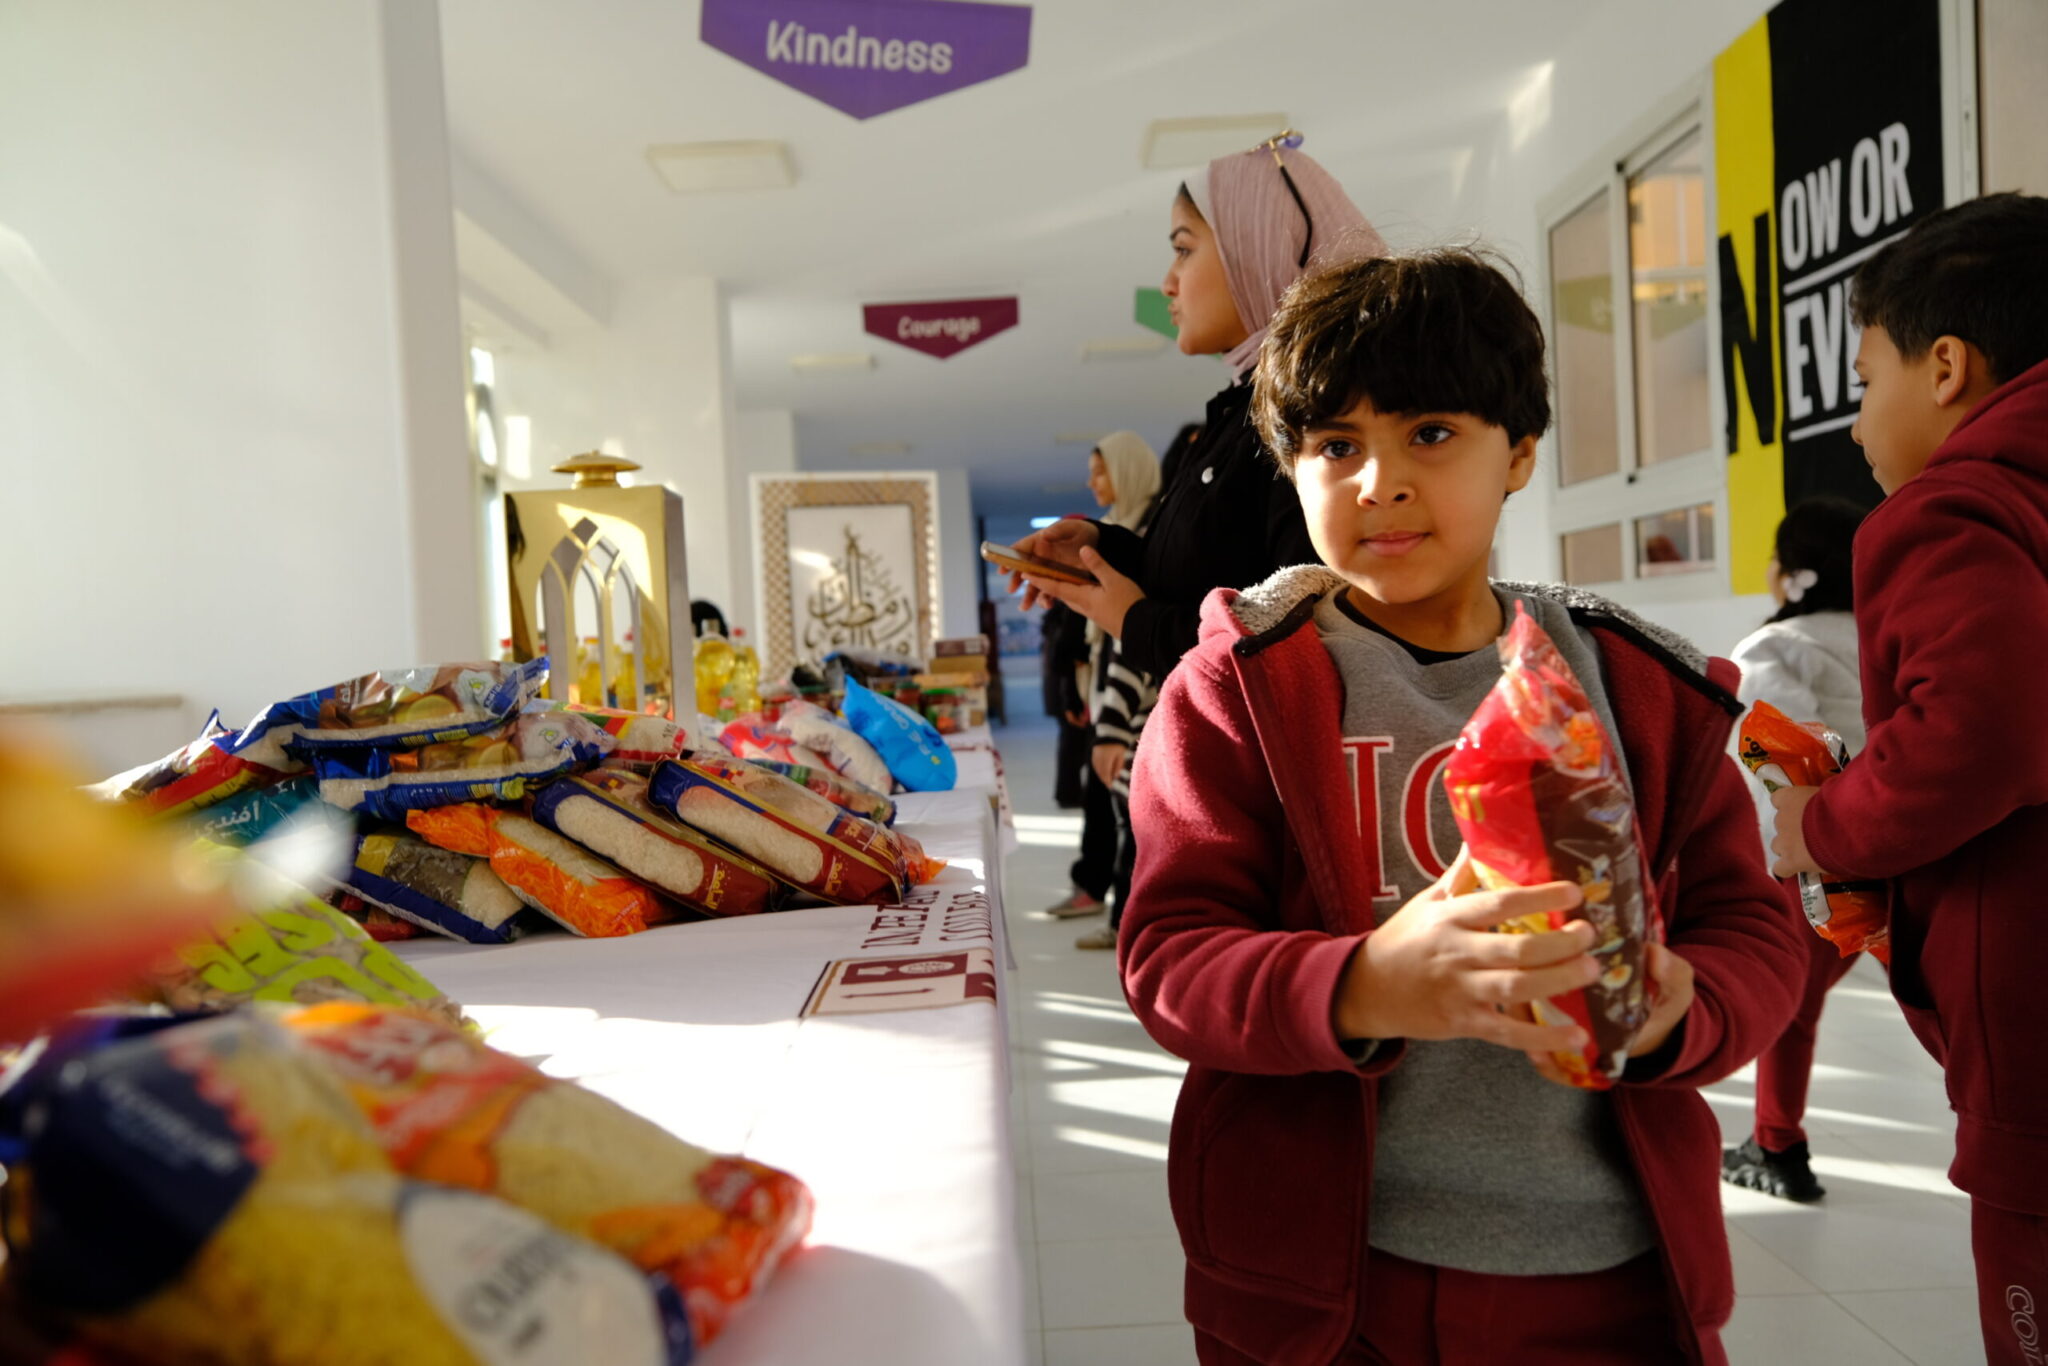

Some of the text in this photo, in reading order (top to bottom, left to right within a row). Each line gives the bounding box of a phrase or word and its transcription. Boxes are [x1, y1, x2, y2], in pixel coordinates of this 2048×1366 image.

[766, 19, 954, 75] Kindness
[1848, 122, 1914, 239] OR
[897, 315, 981, 342] Courage
